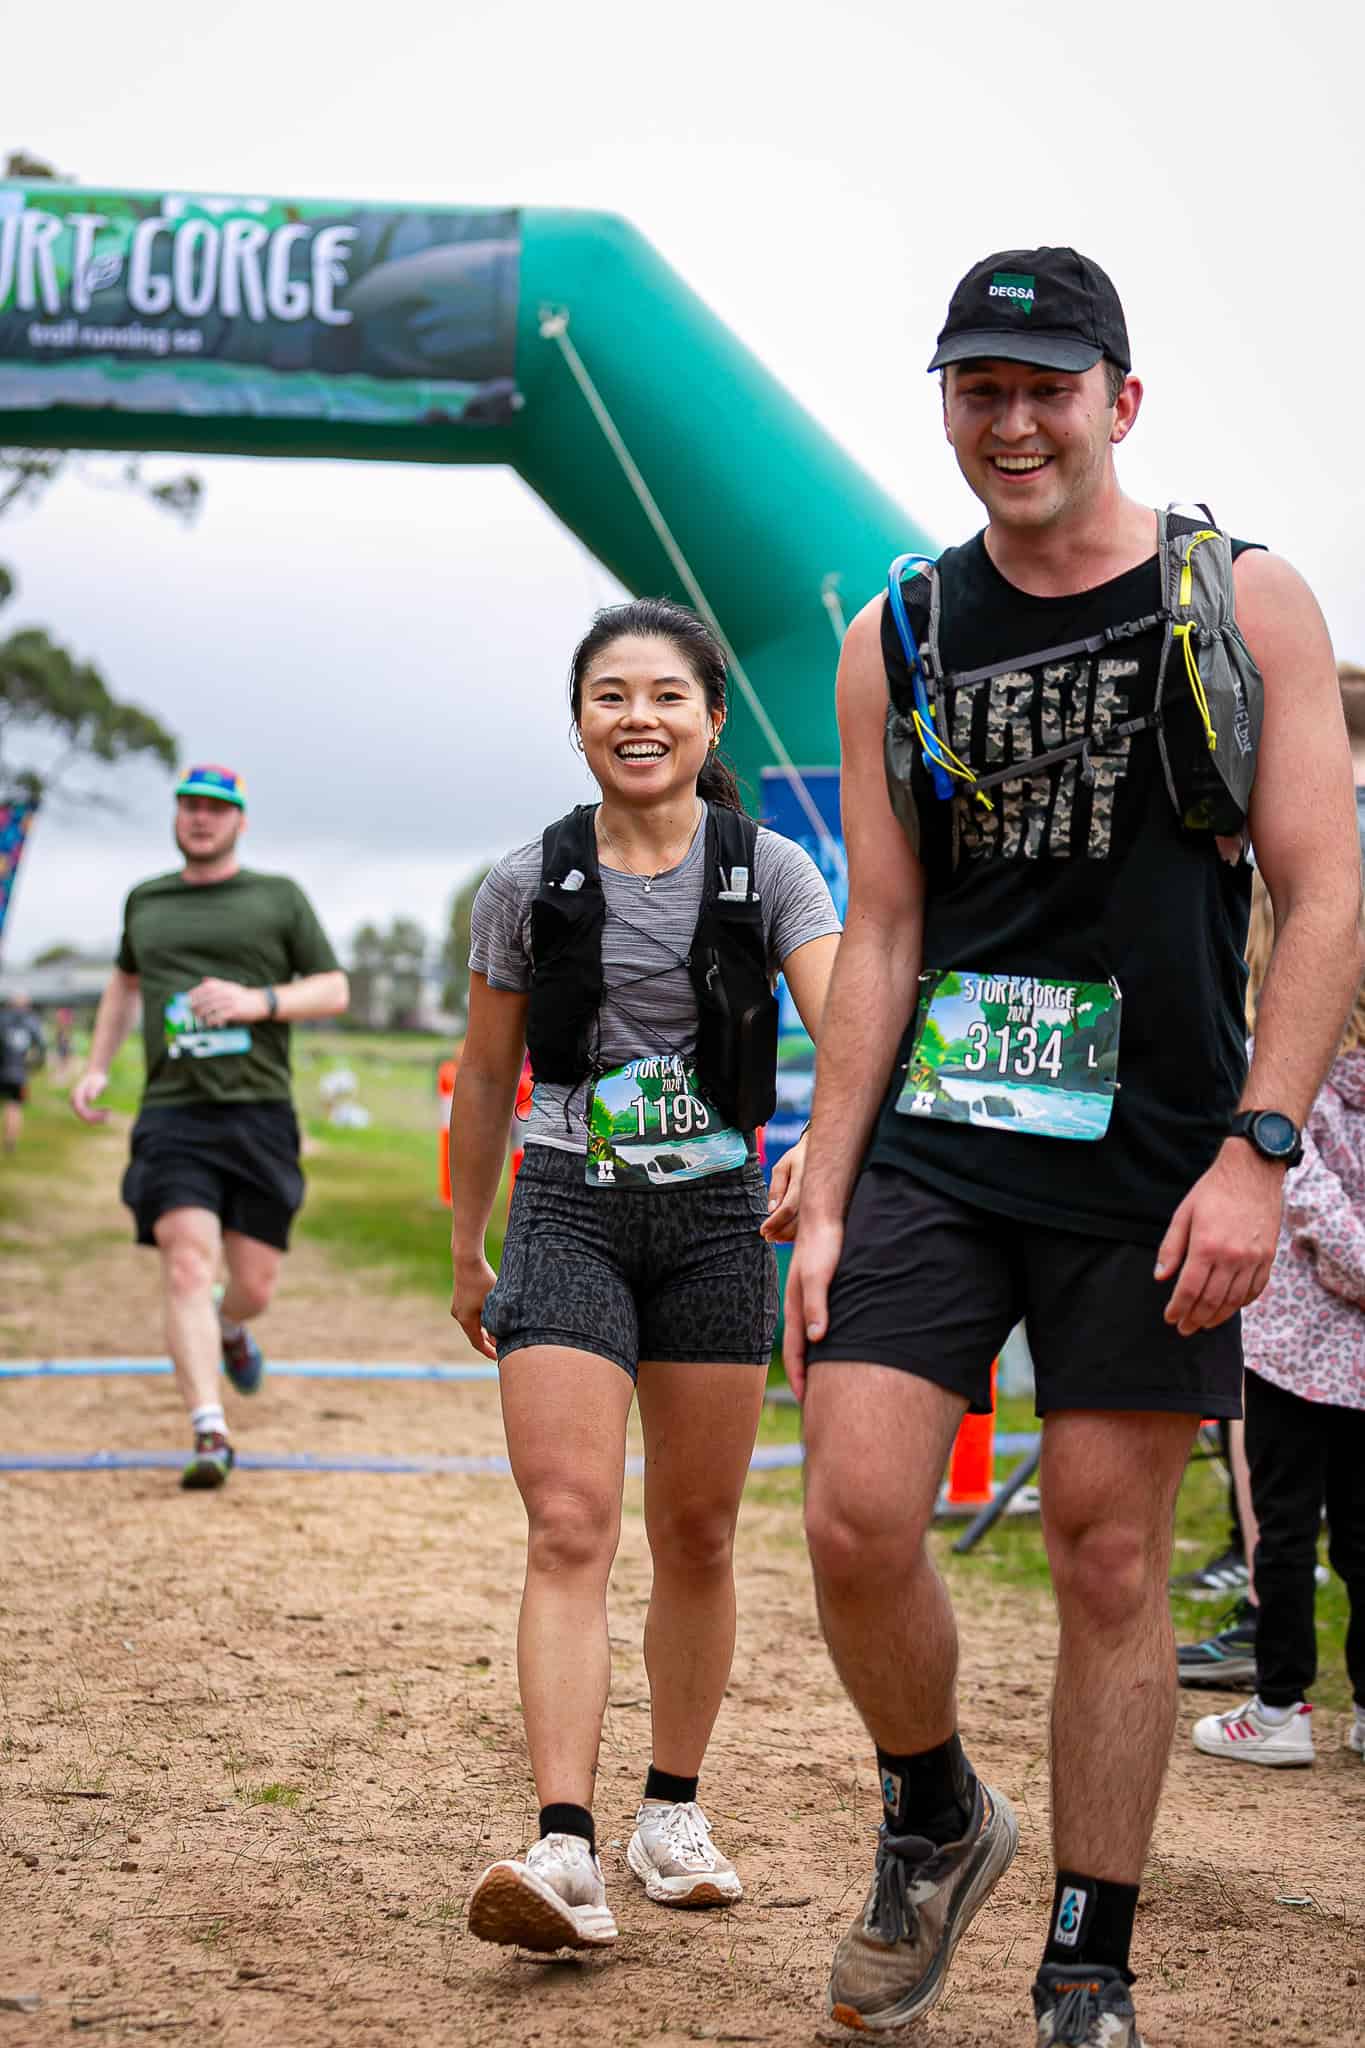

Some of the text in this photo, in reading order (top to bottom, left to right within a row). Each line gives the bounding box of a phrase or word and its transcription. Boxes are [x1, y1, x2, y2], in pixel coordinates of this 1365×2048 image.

[128, 217, 360, 325] GORGE
[988, 285, 1035, 300] DEGSA
[964, 978, 1077, 1010] STURT GORGE
[964, 1021, 1098, 1079] 3134 L
[624, 1058, 665, 1080] STURT
[662, 1078, 682, 1092] 2024
[631, 1094, 709, 1136] 1199
